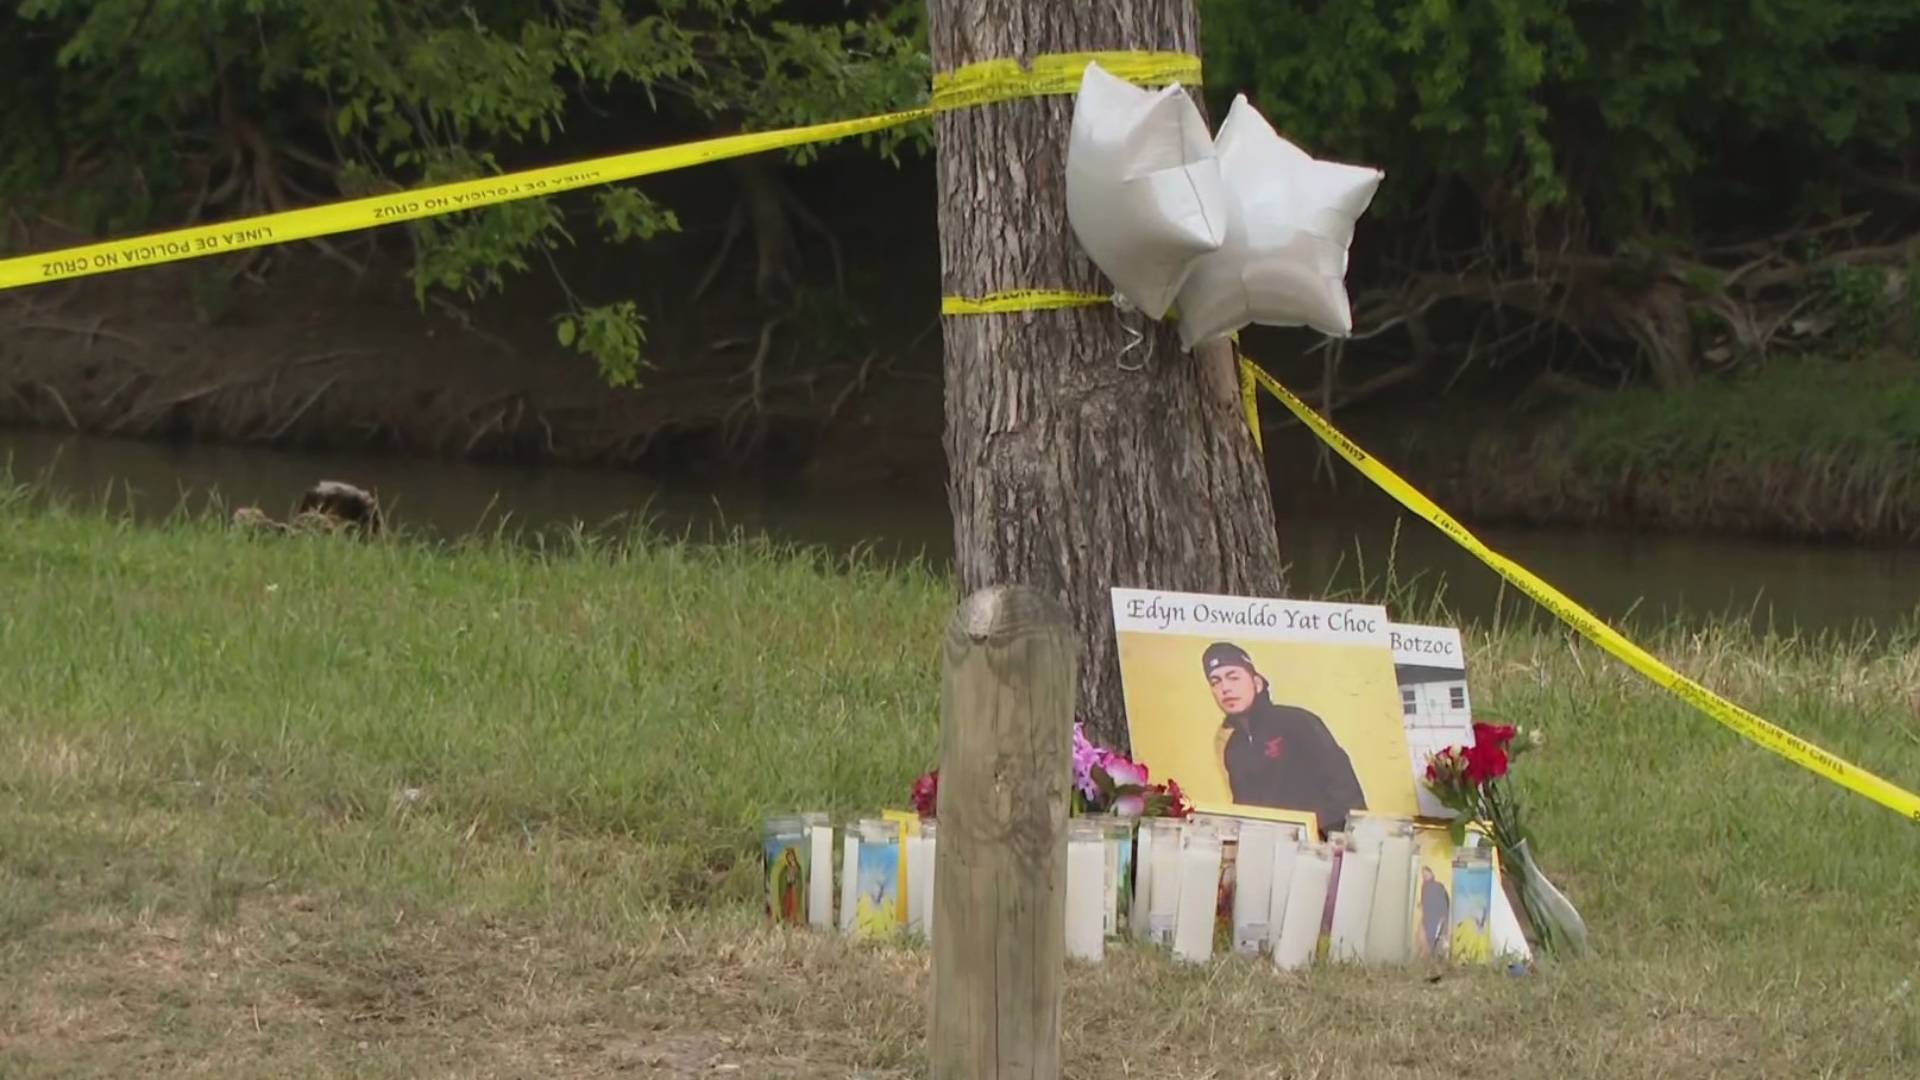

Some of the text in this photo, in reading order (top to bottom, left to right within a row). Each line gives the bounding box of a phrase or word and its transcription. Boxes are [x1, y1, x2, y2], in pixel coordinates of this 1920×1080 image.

[373, 202, 420, 219] CRUZ
[424, 198, 448, 208] NO
[42, 226, 273, 277] LINEA DE POLICIA NO CRUZ
[1126, 596, 1377, 634] Edyn Oswaldo Yat Choc
[1390, 631, 1453, 656] Botzoc
